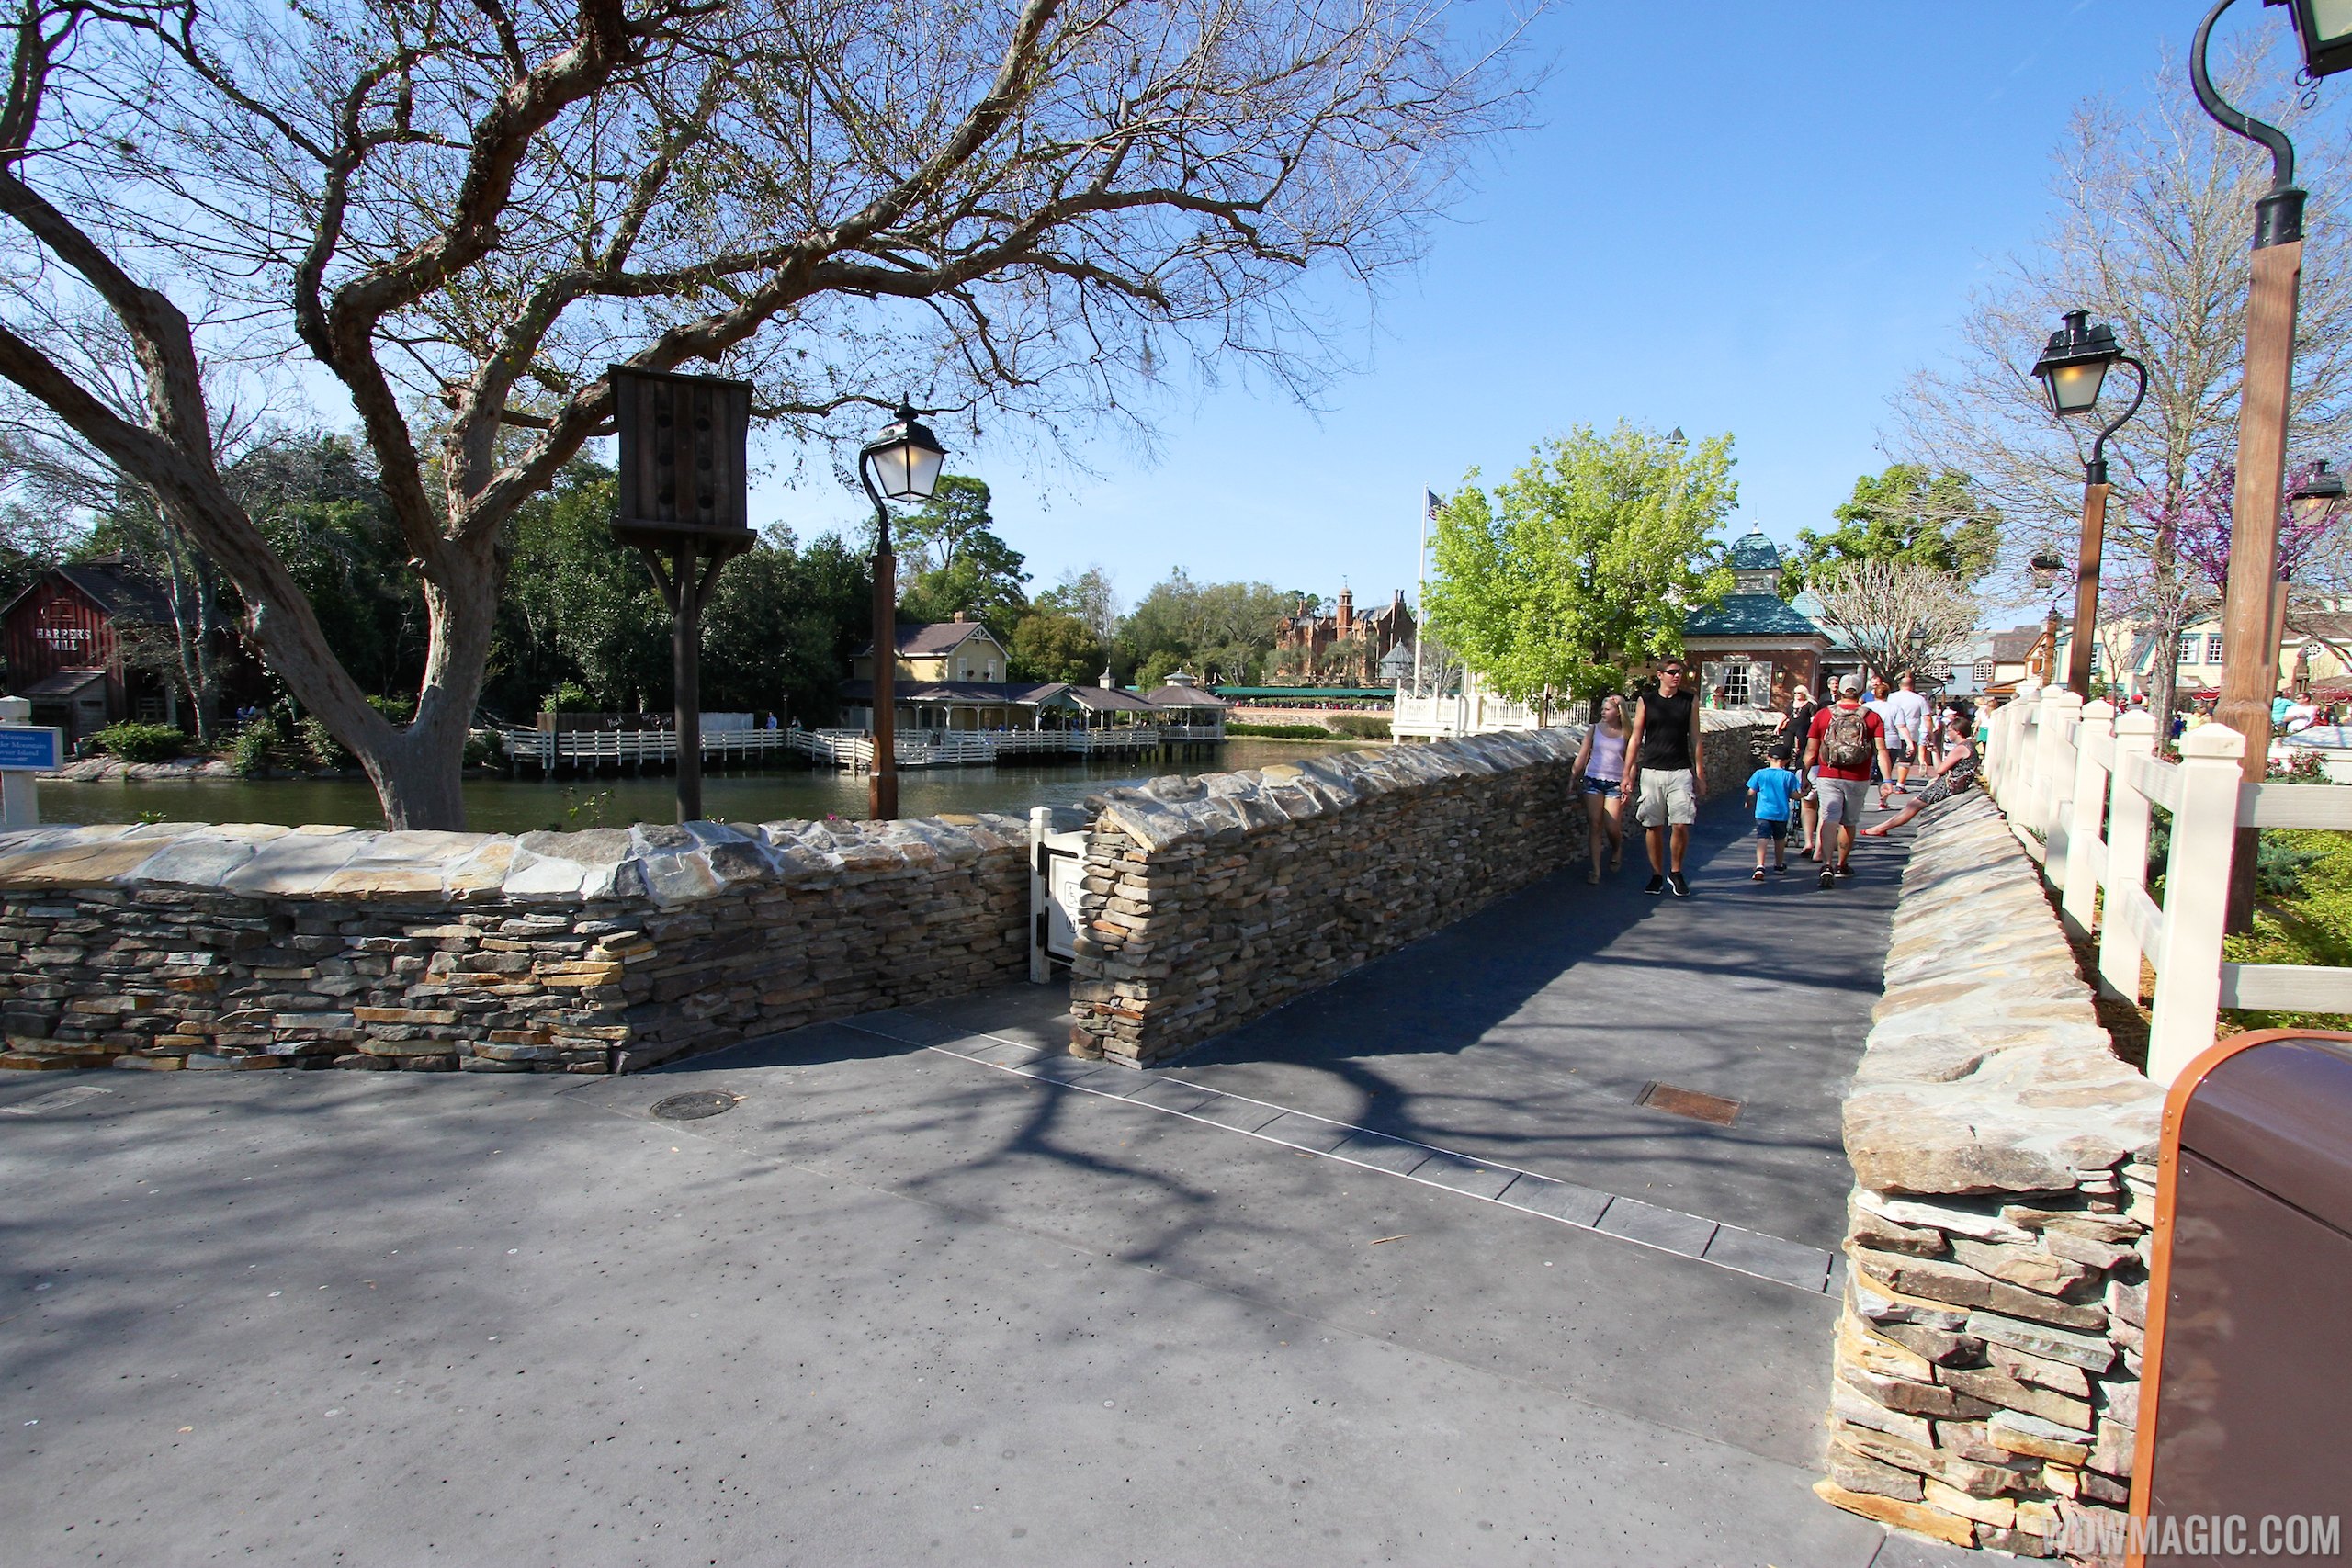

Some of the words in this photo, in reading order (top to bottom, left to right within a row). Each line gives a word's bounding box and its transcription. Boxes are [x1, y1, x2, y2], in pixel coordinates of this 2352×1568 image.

[36, 628, 91, 640] HARPER'S
[49, 640, 78, 650] MILL
[0, 733, 35, 741] Mountain
[17, 749, 39, 757] Island
